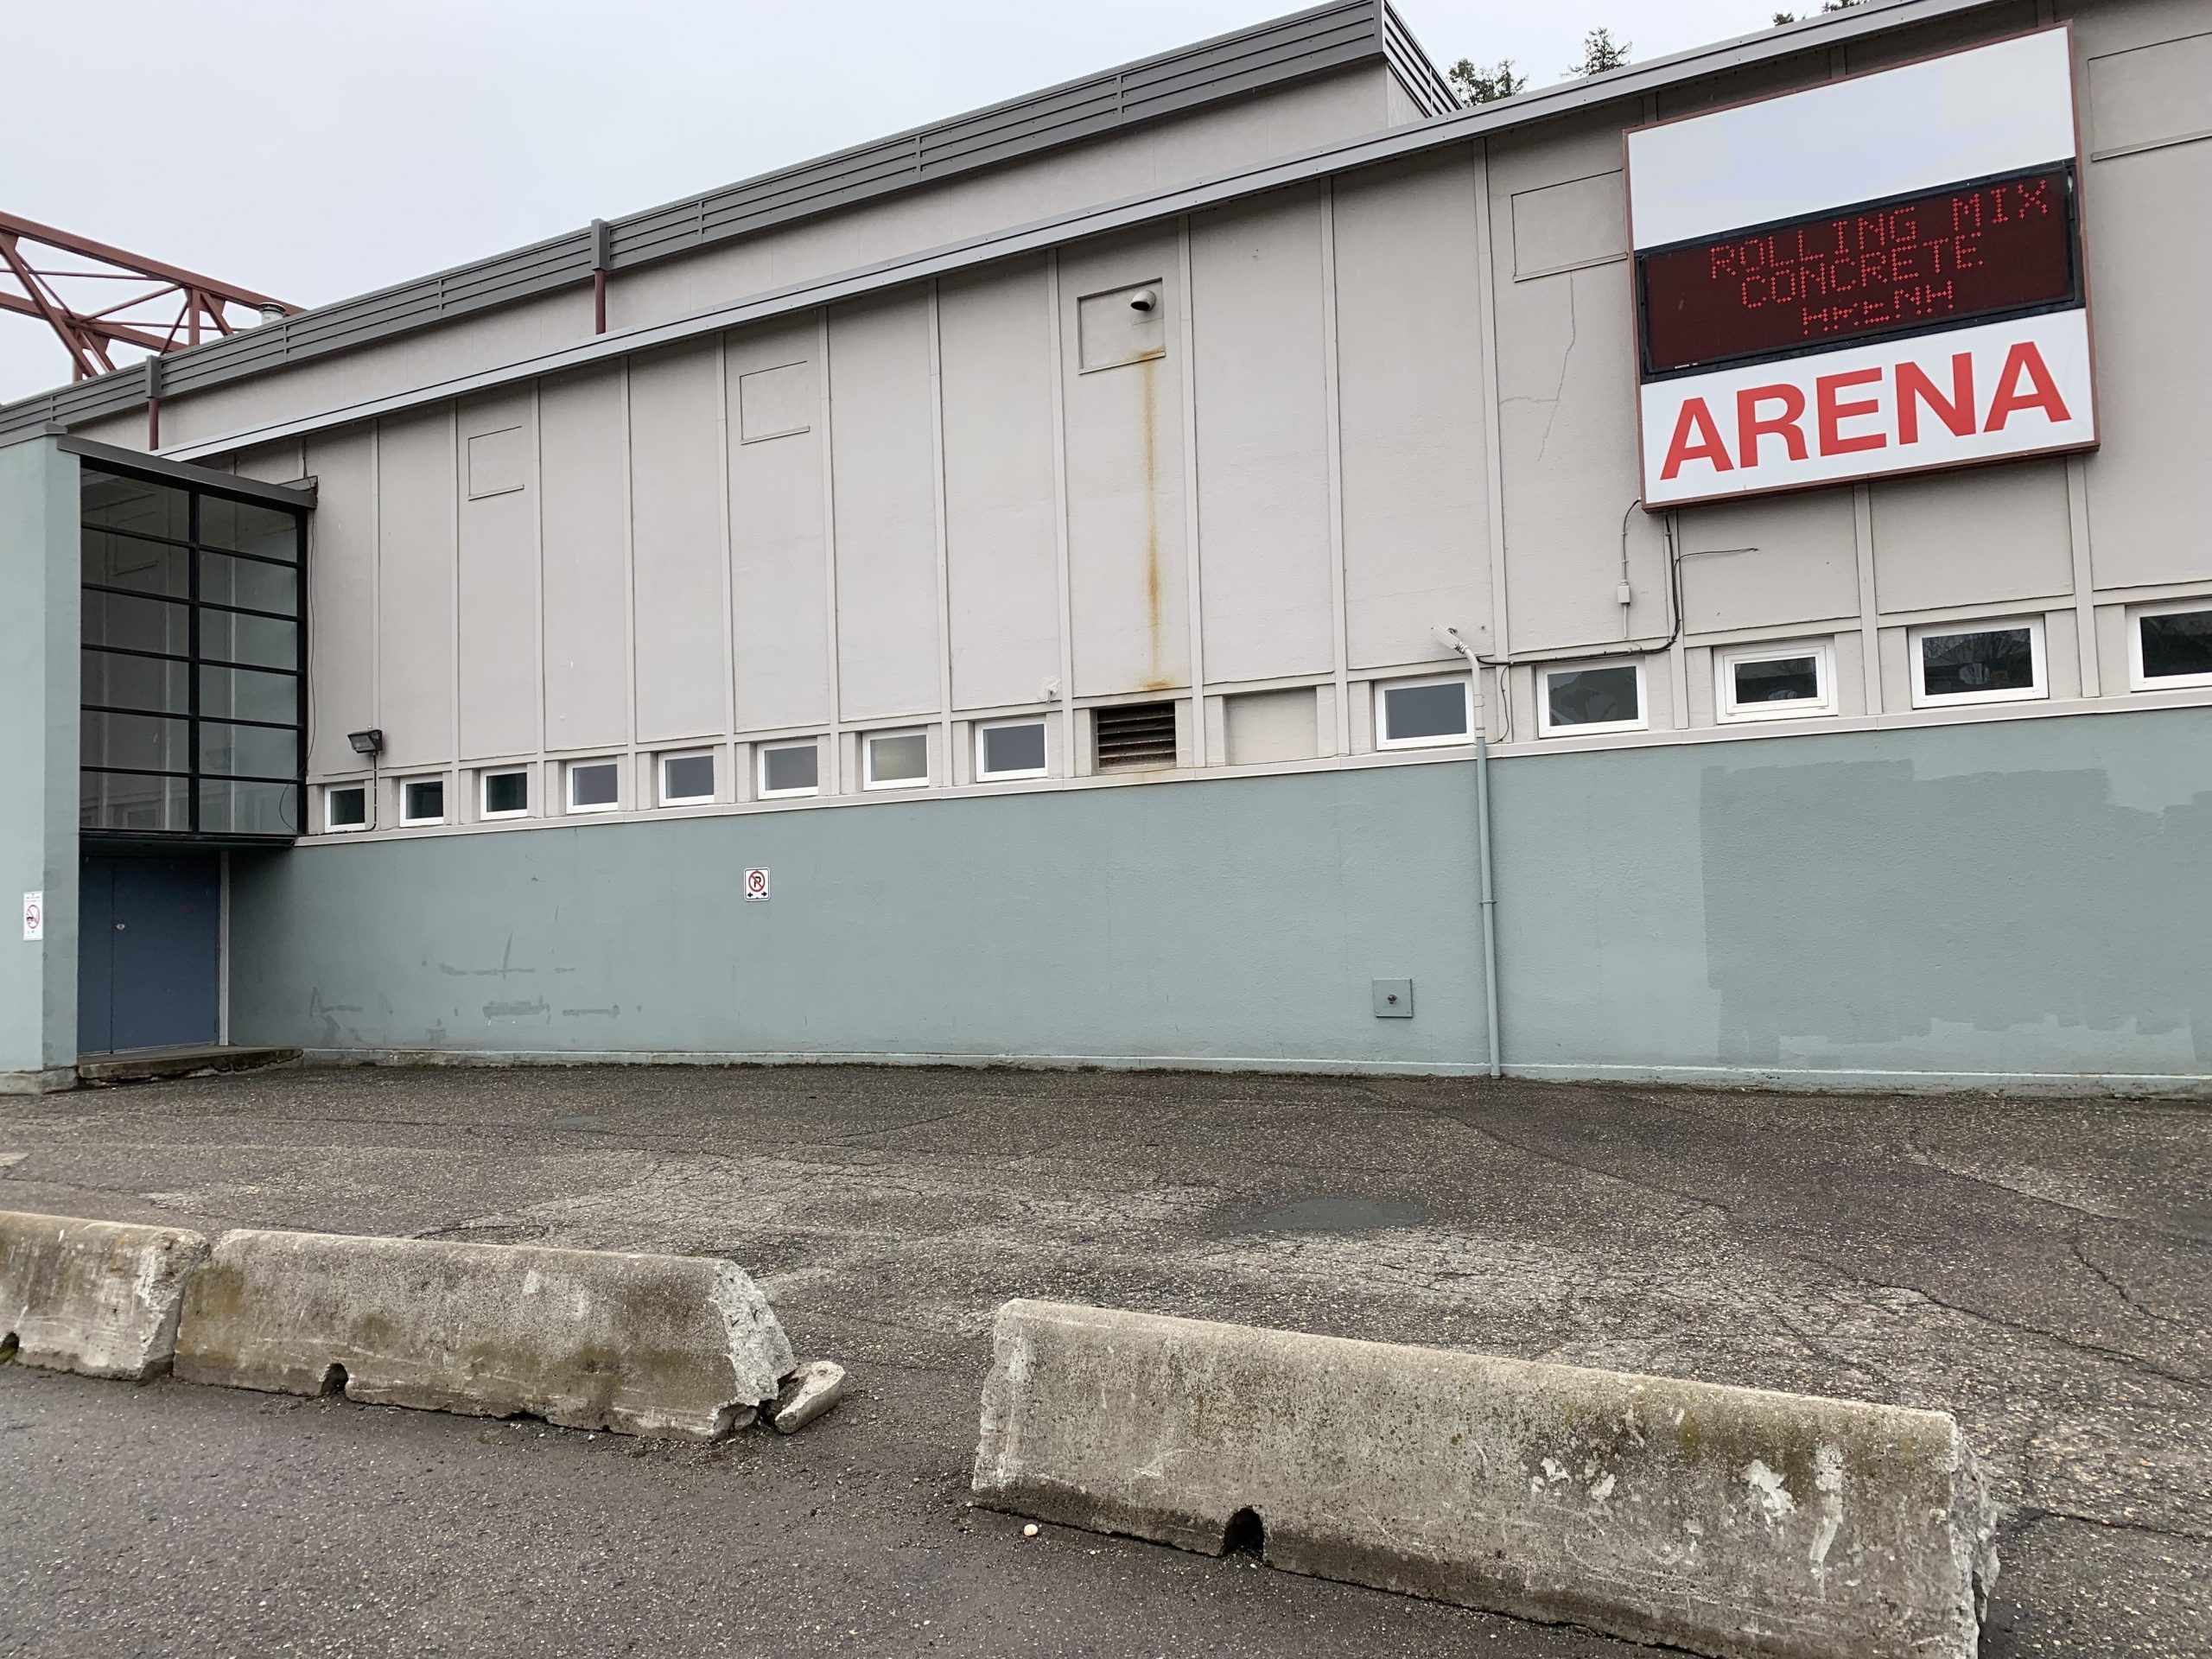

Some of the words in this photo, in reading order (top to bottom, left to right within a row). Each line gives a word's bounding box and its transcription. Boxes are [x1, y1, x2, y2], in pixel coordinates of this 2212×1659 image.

[1710, 206, 1916, 280] ROLLING
[1953, 179, 2048, 232] MIX
[1740, 231, 1984, 309] CONCRETE
[1660, 341, 2072, 480] ARENA
